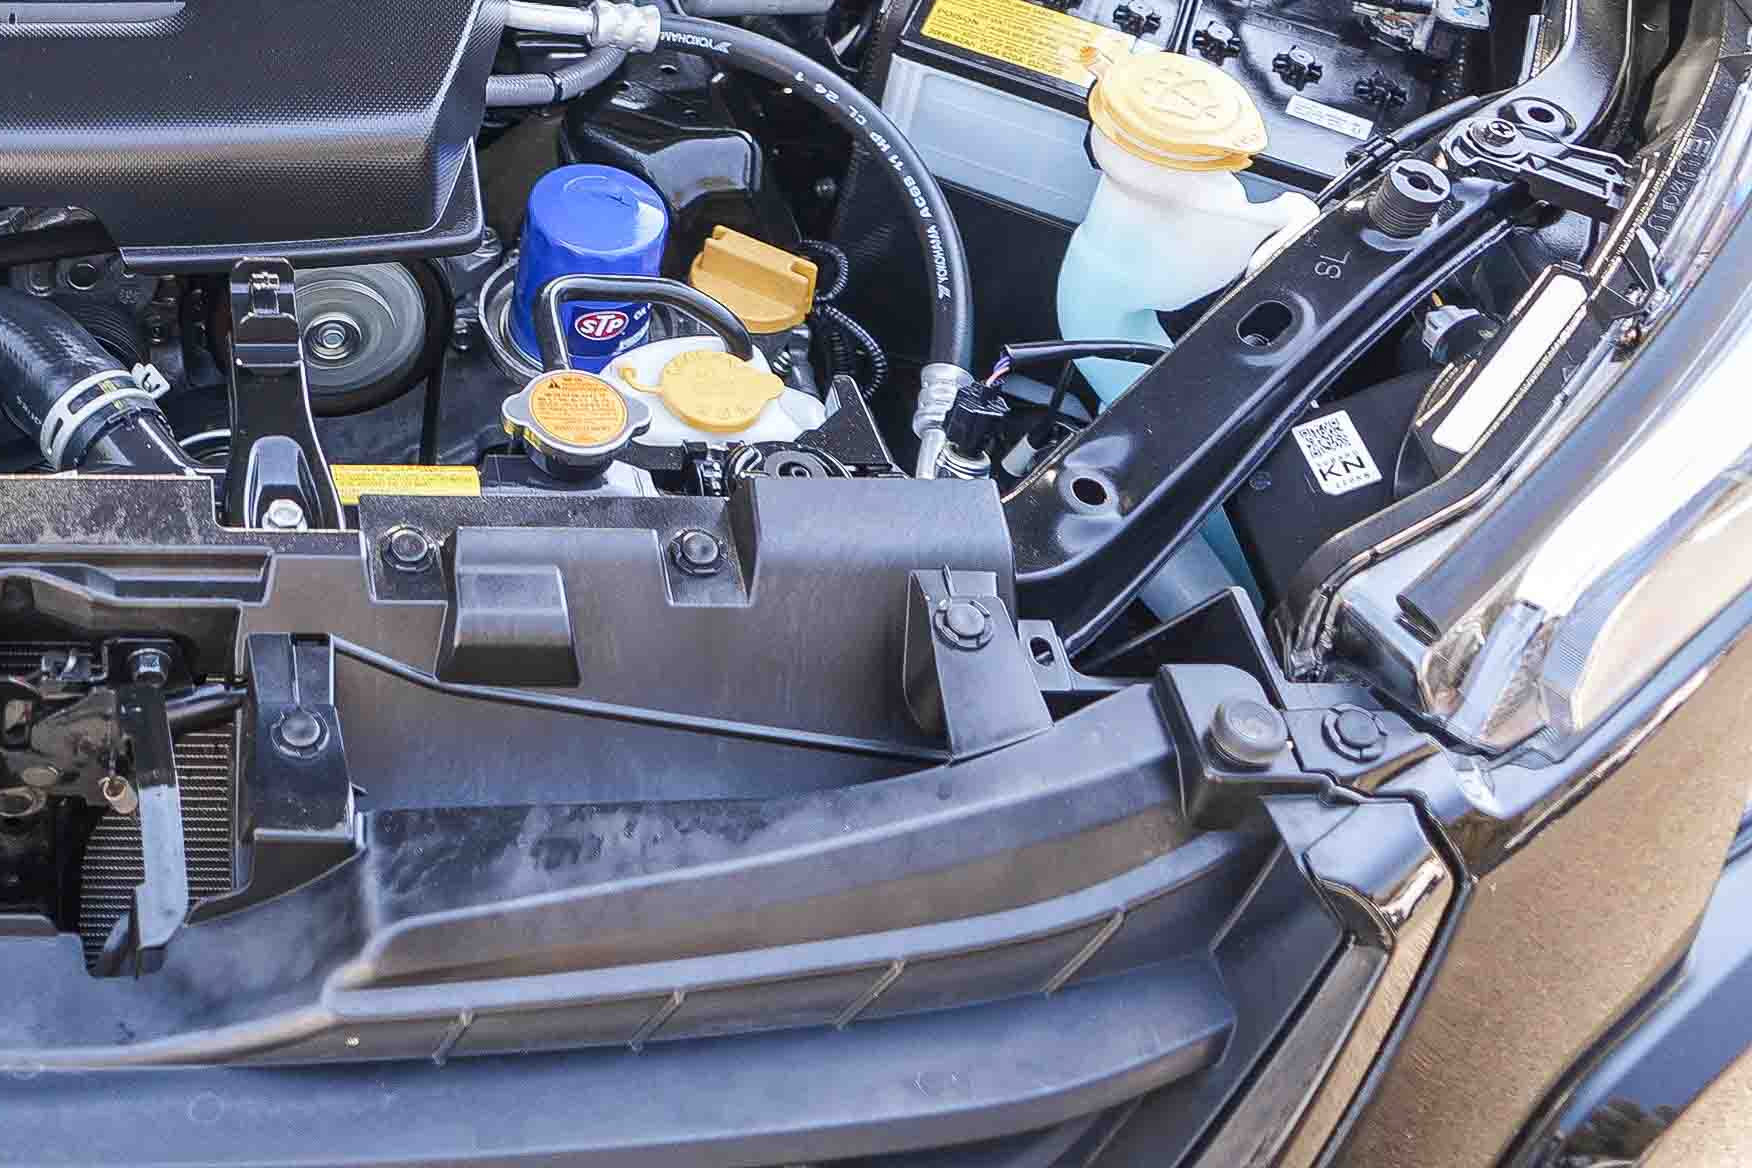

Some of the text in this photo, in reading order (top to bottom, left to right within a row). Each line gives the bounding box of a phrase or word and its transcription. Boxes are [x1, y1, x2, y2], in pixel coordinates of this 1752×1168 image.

[659, 31, 715, 50] YOKOHAM
[847, 104, 868, 127] CL
[868, 130, 891, 153] HP
[927, 224, 951, 284] YOKOHAMA
[1314, 249, 1351, 280] SL
[579, 313, 625, 337] STP
[1318, 455, 1367, 483] KN
